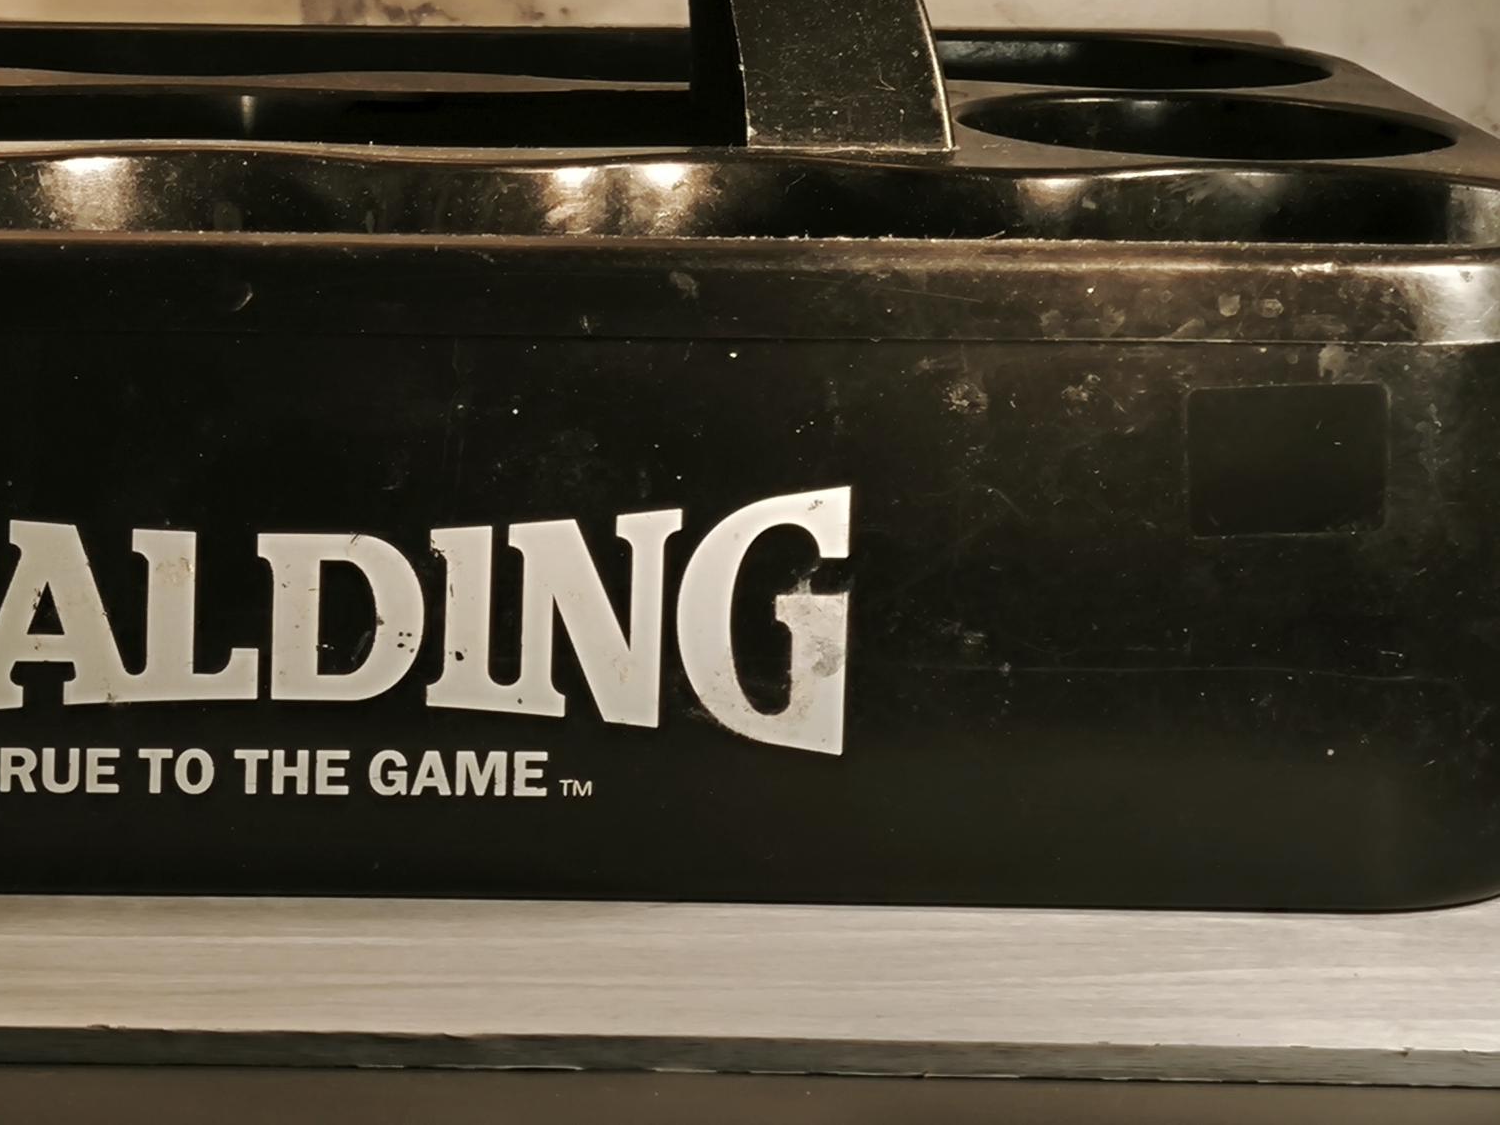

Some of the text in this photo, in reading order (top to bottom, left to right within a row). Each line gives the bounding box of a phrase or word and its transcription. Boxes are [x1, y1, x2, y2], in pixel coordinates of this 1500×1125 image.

[137, 747, 215, 795] TO
[233, 748, 351, 796] THE
[368, 749, 549, 797] GAME
